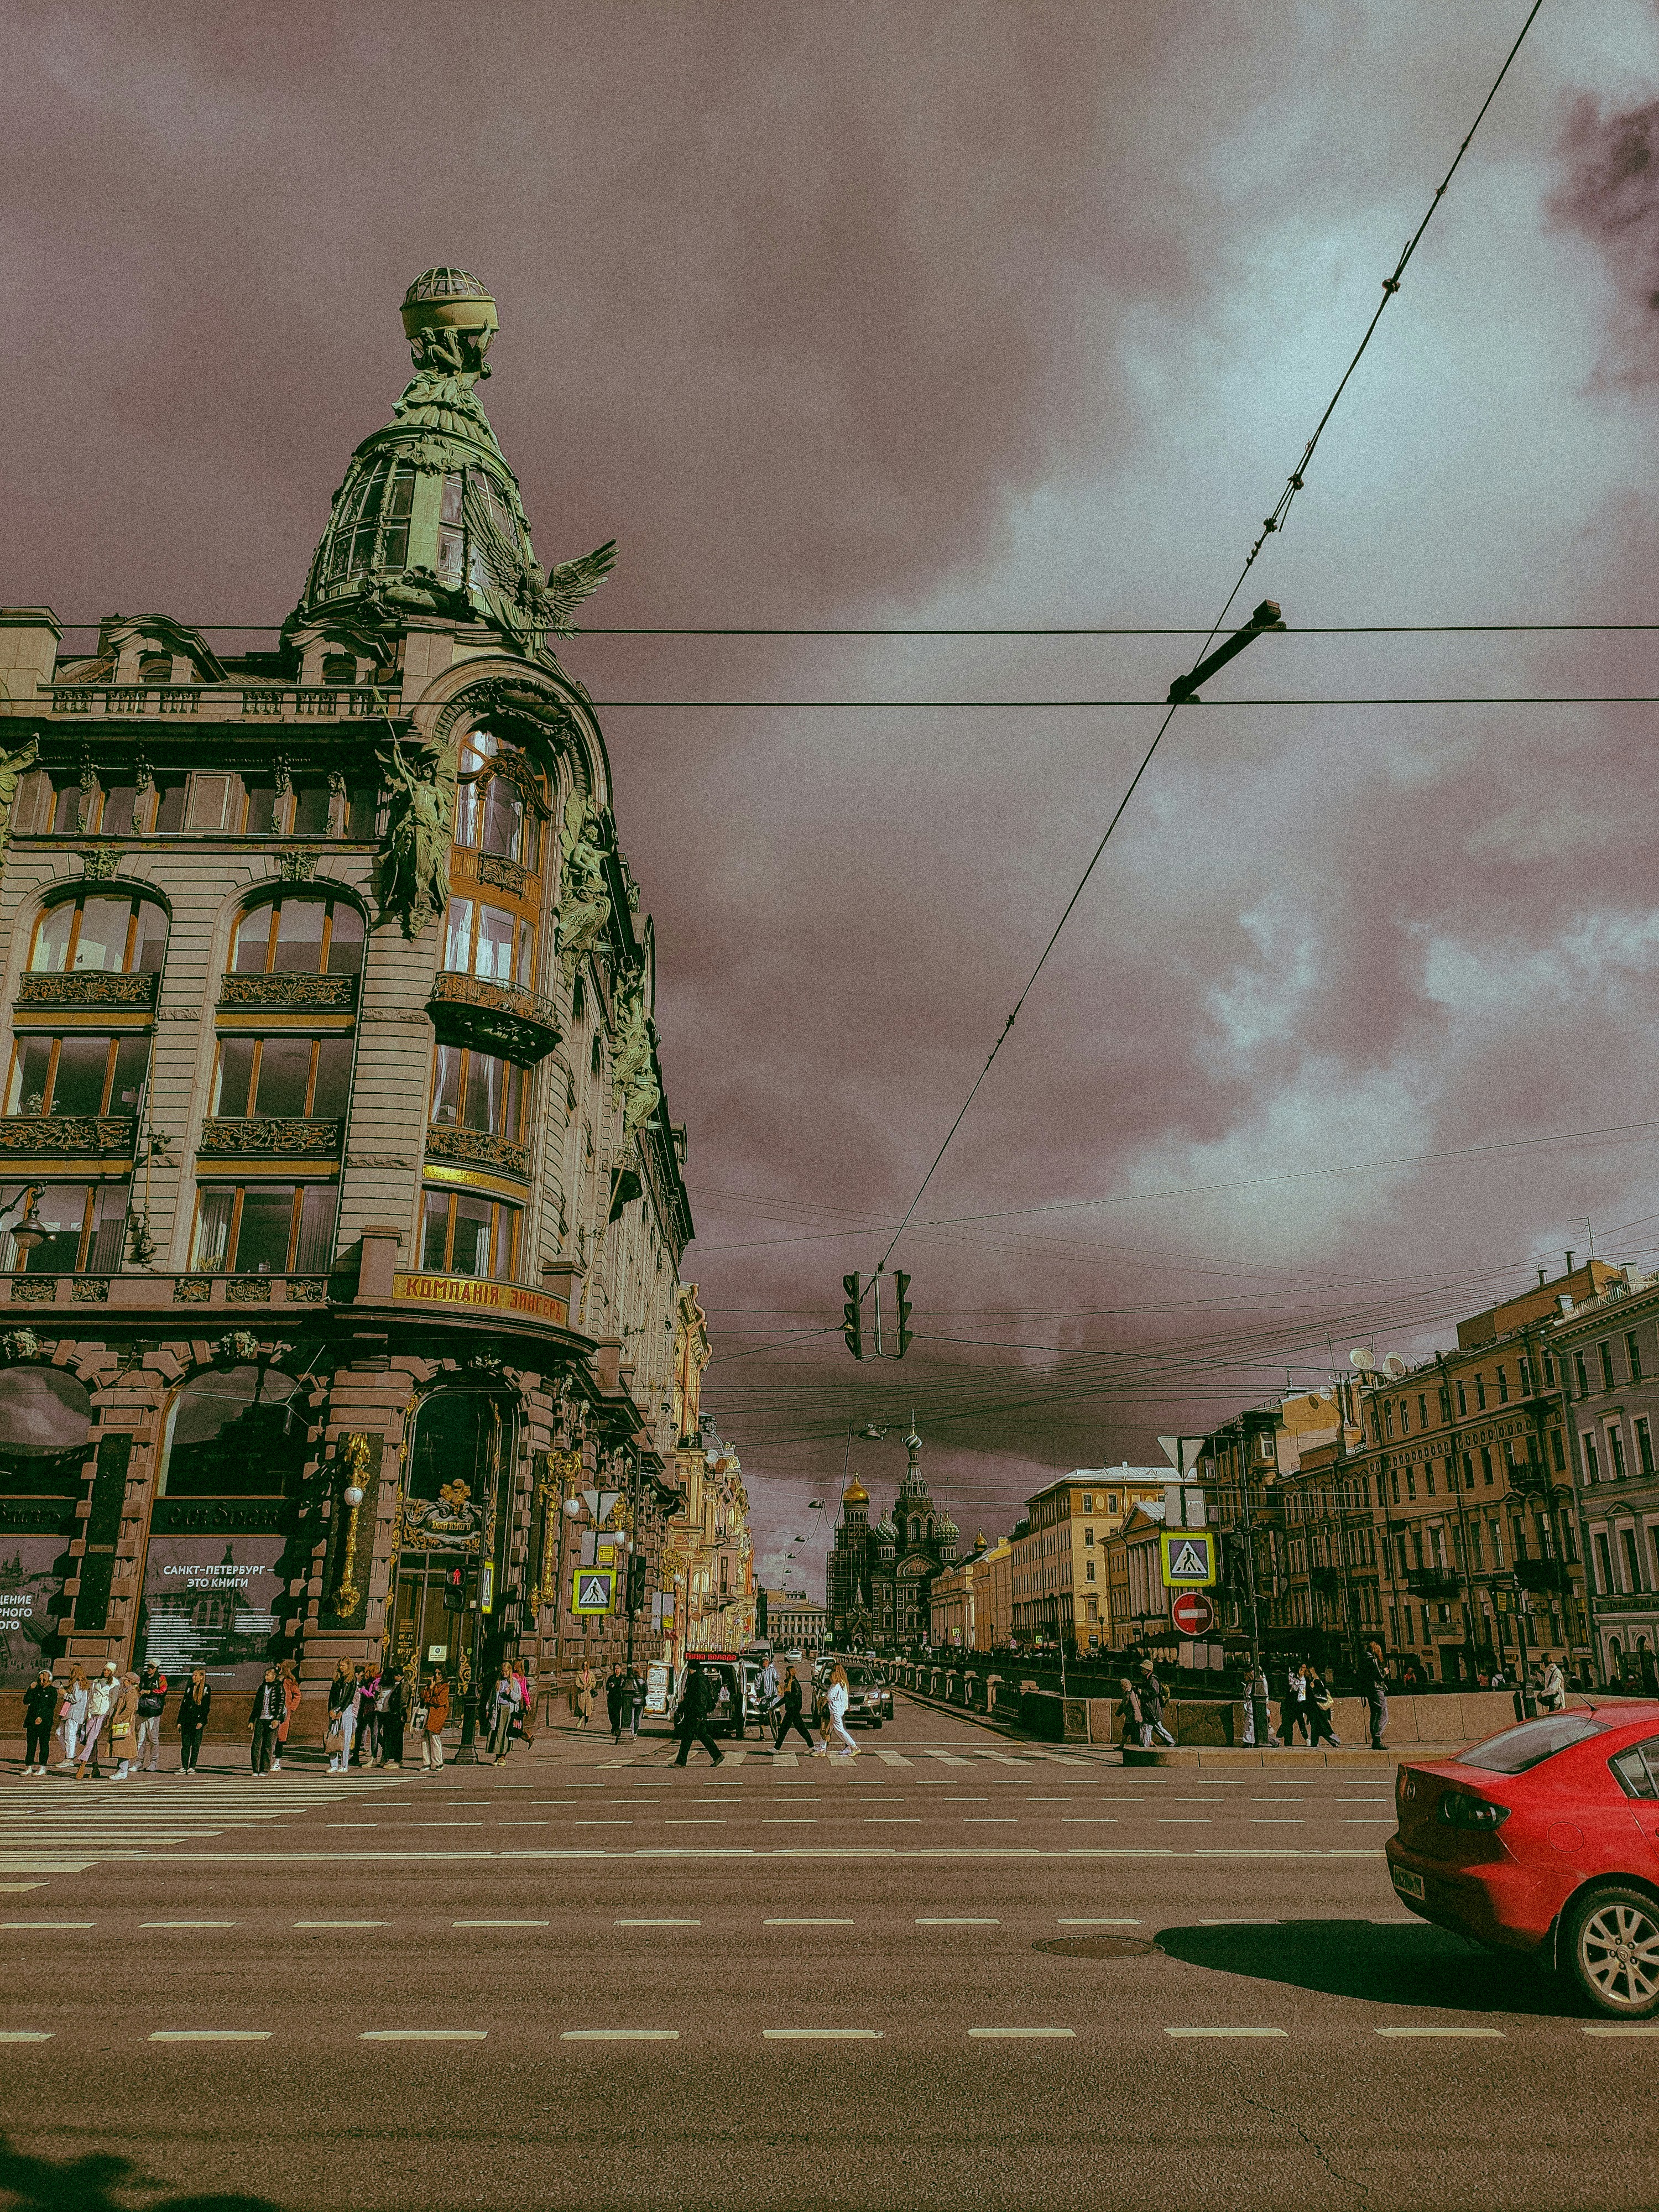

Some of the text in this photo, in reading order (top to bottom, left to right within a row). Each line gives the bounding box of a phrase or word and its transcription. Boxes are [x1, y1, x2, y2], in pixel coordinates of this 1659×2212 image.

[406, 1278, 561, 1321] КОМПАНІЯ ЗИНГЕРЪ
[163, 1565, 265, 1575] САНКТ-ПЕТЕРБУРГ
[186, 1578, 248, 1588] ЭТО КНИГИ
